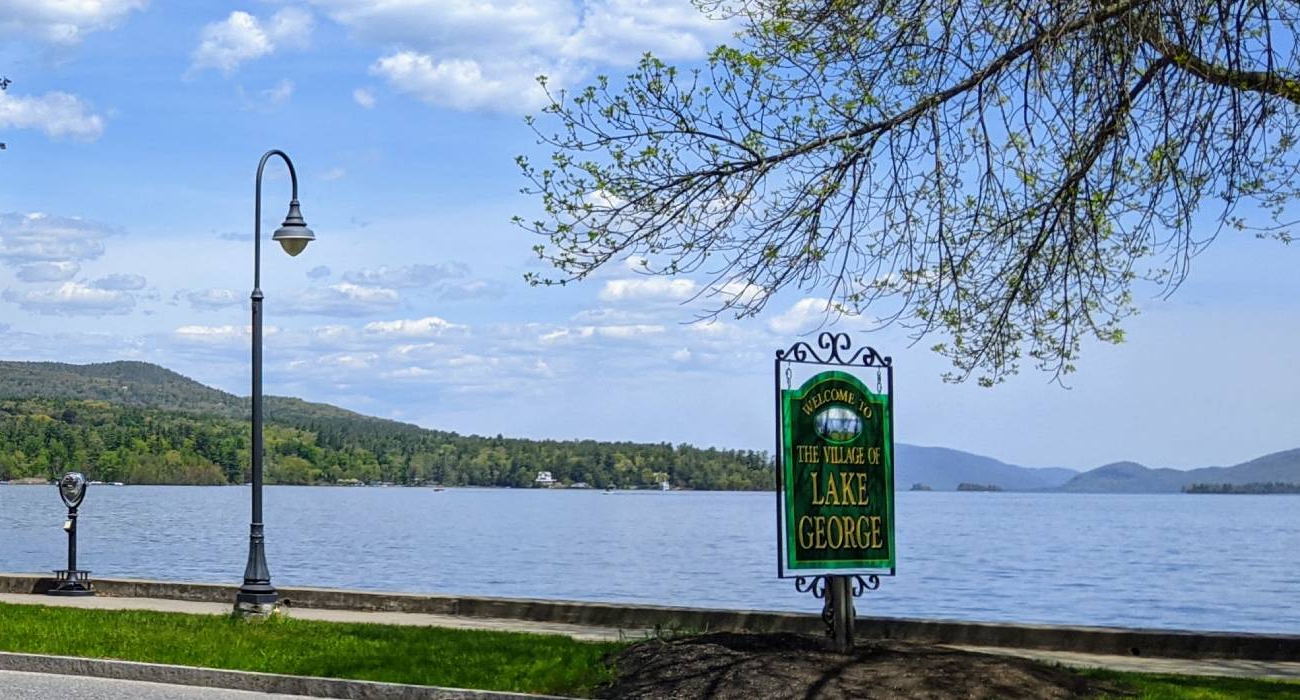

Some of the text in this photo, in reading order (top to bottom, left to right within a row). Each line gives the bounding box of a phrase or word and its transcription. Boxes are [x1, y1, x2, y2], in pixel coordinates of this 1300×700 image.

[802, 388, 872, 418] WELCOME TO
[796, 445, 881, 465] THE VILLAGE OF
[810, 471, 869, 506] LAKE
[798, 515, 883, 550] GEORGE
